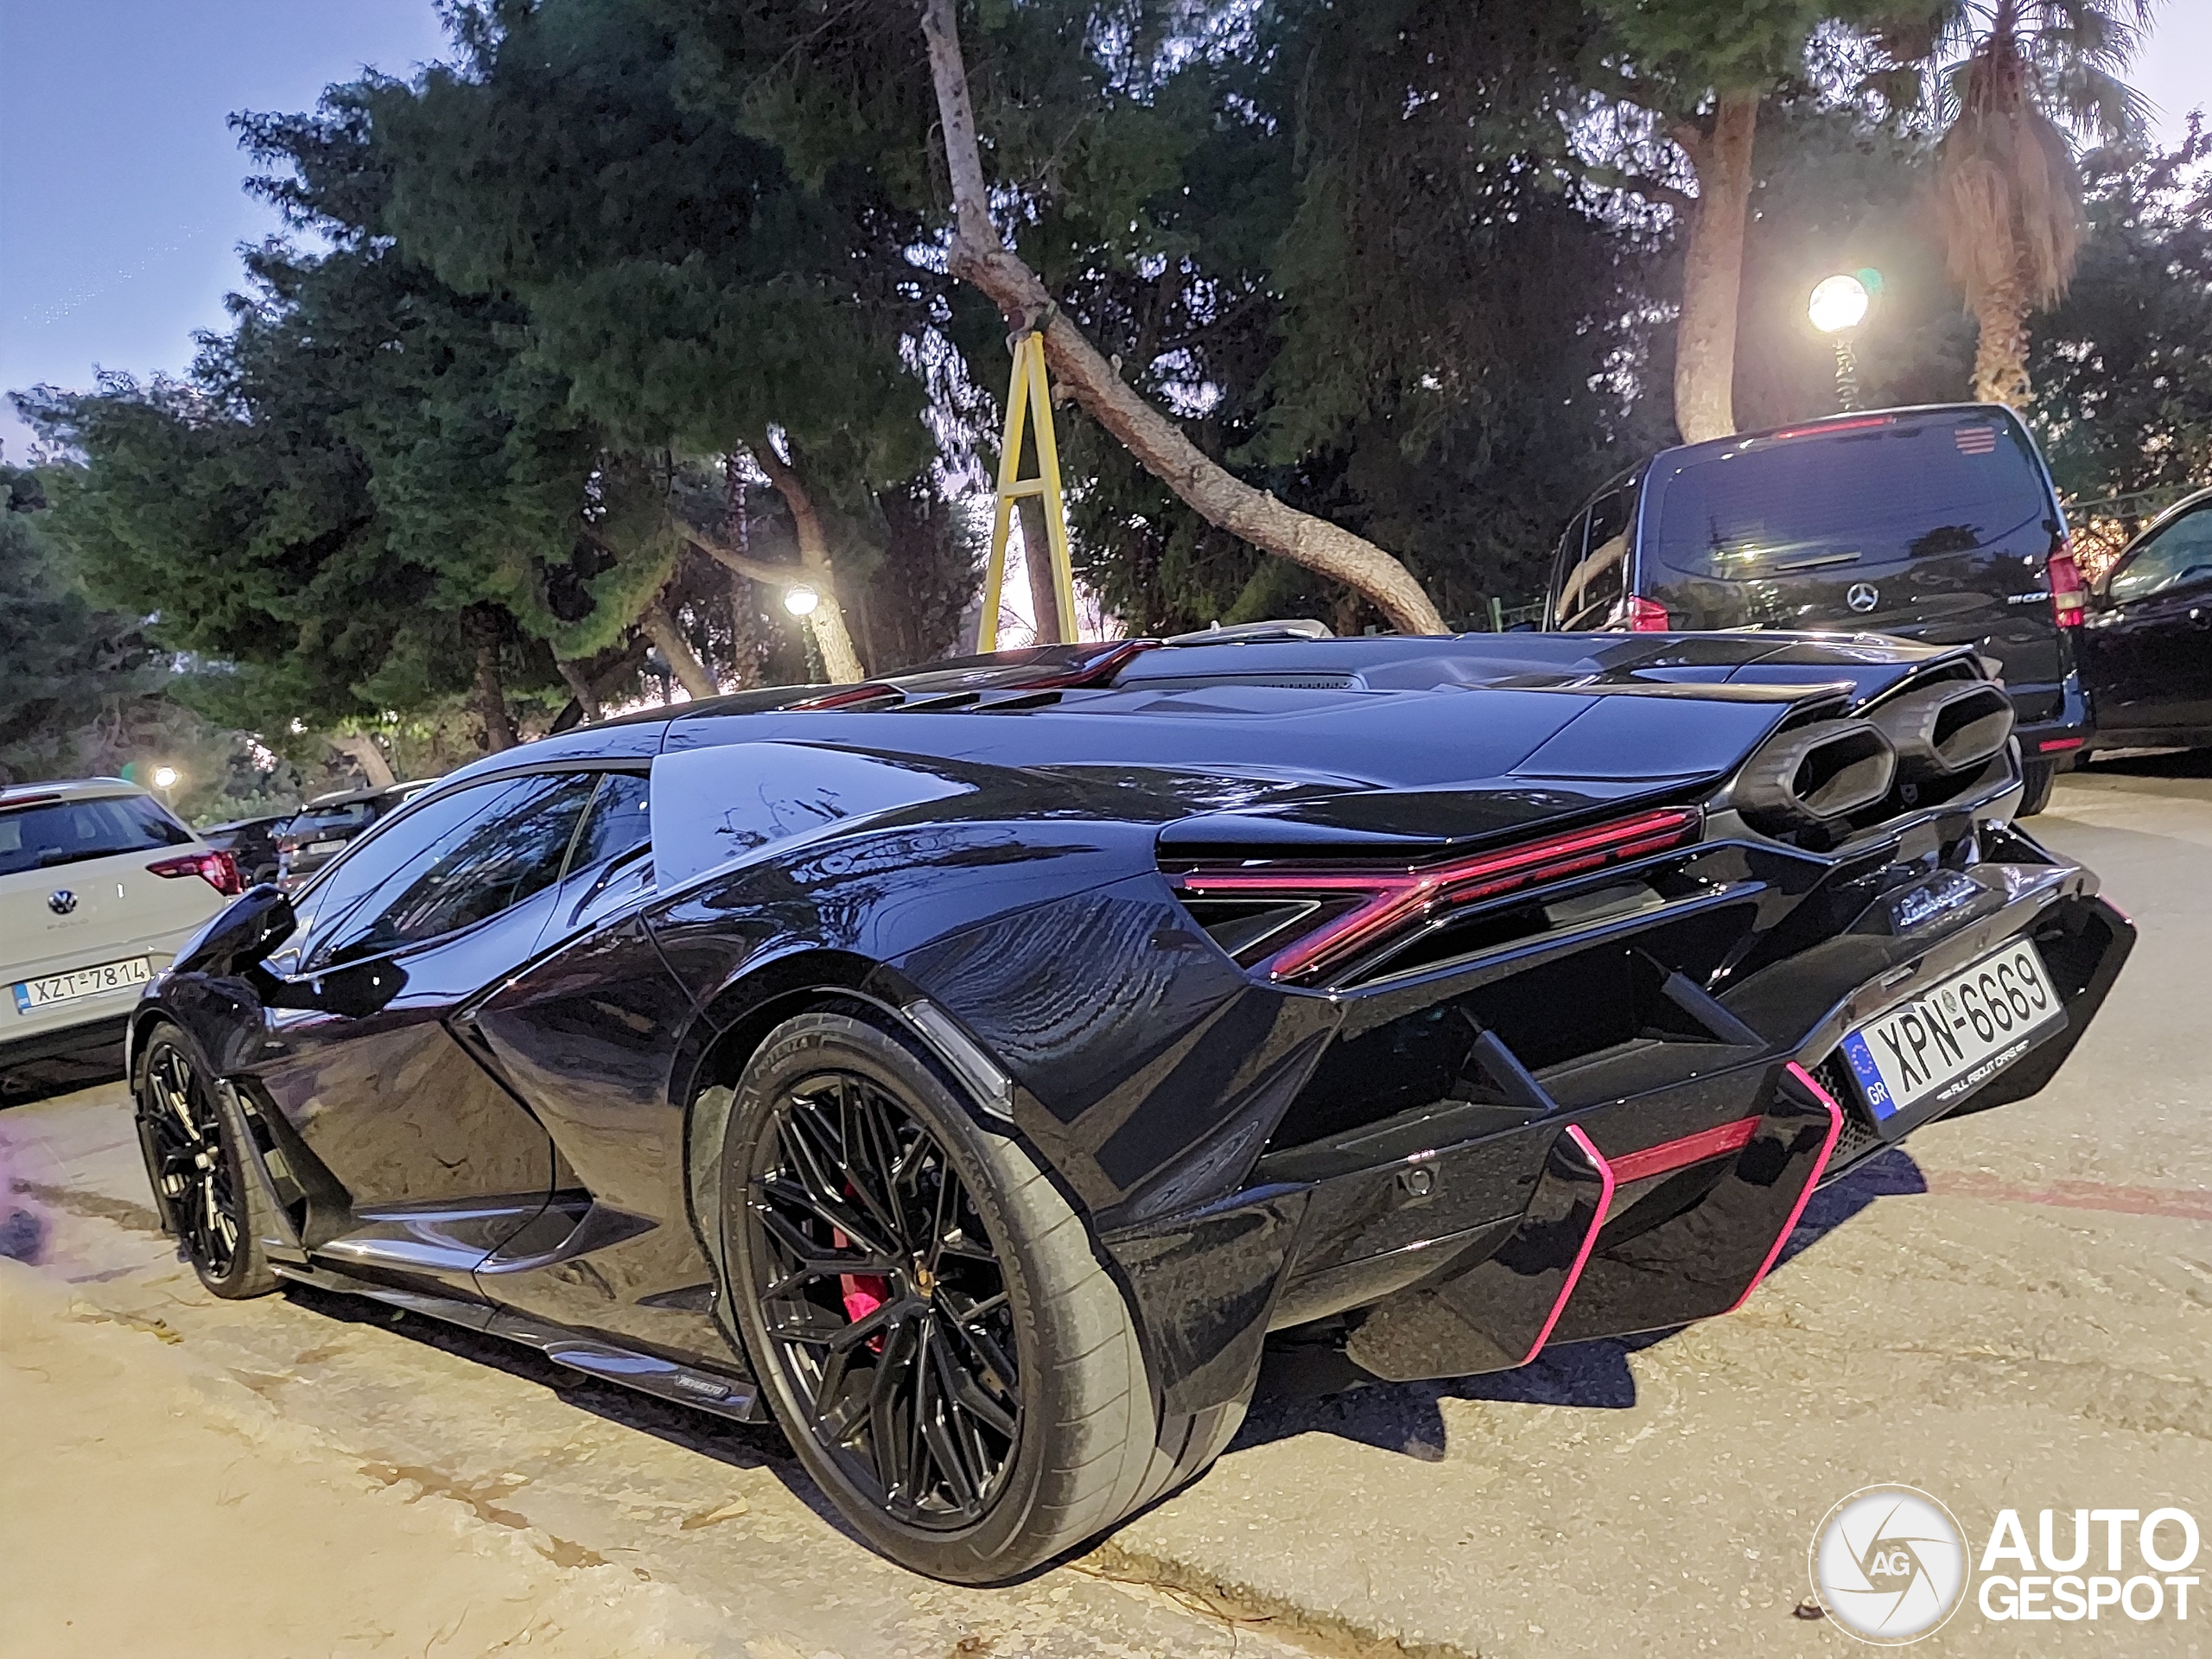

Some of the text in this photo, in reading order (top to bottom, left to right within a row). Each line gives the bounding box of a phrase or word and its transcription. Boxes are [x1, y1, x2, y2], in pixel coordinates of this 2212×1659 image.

[35, 962, 146, 1002] XZT-7814
[1878, 952, 2048, 1092] XPN-6669
[1866, 1082, 1890, 1105] GR
